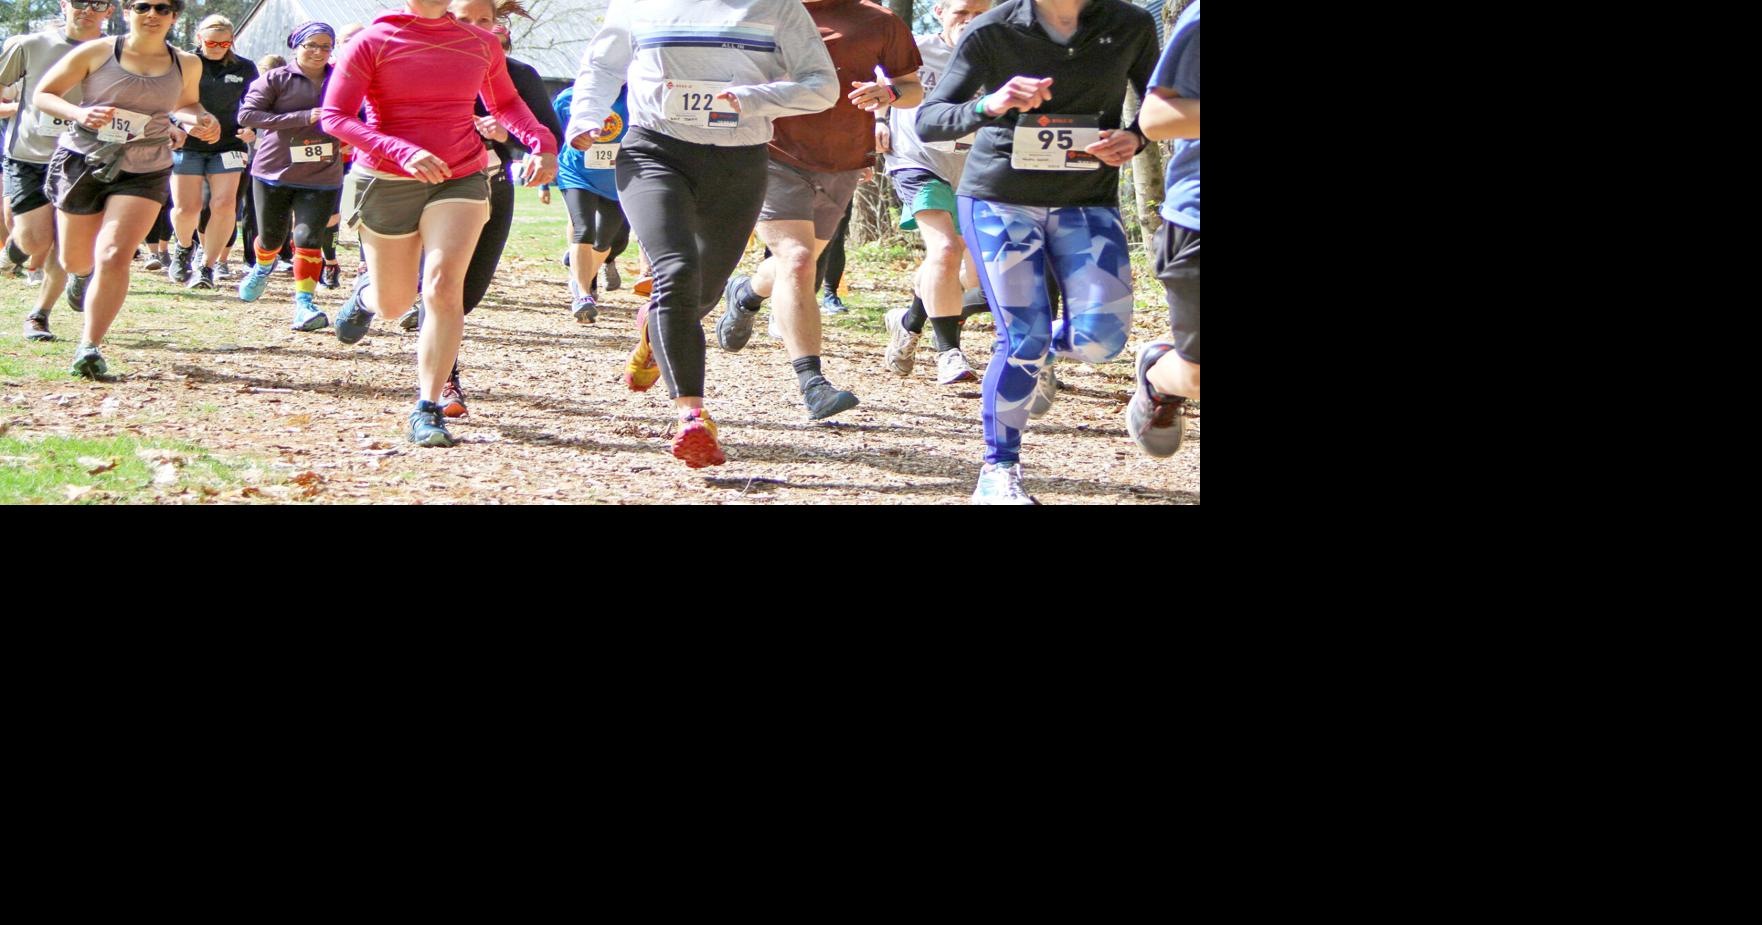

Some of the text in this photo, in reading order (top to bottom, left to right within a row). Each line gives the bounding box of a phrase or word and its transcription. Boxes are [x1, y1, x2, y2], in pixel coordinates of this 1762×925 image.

[682, 92, 713, 111] 122
[111, 117, 131, 132] 152
[1037, 129, 1073, 150] 95
[304, 146, 323, 157] 88
[595, 150, 613, 160] 129
